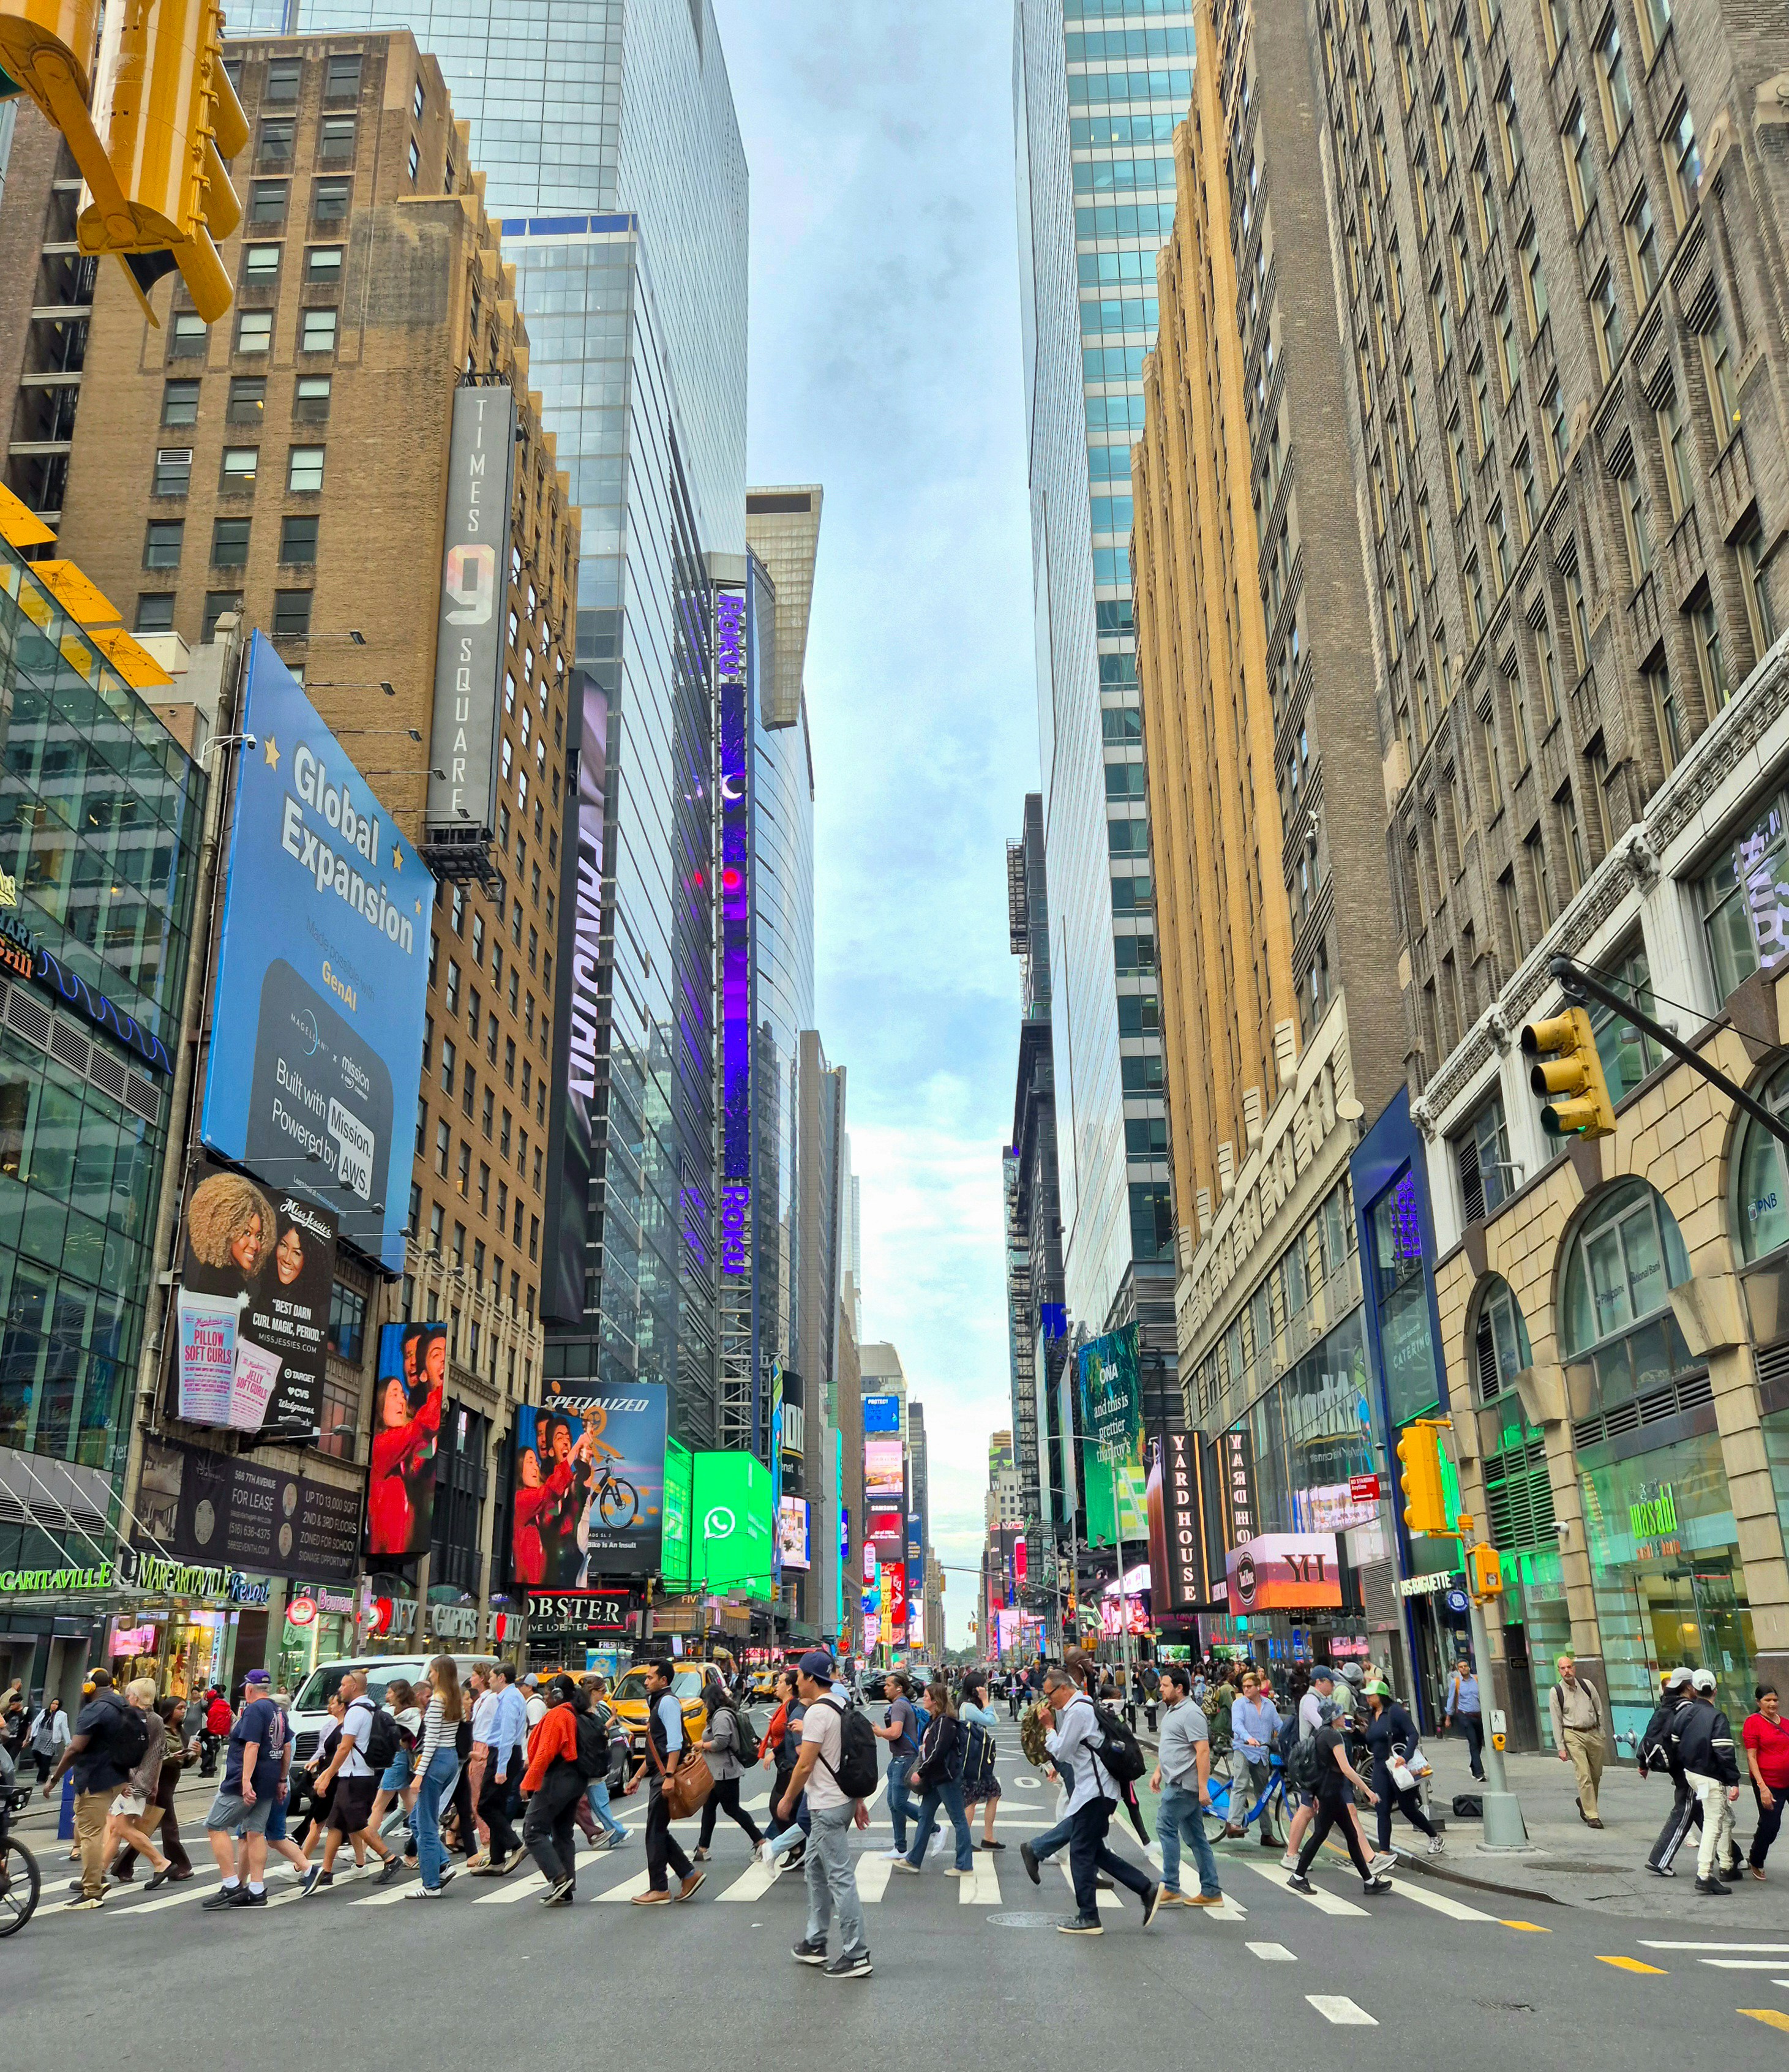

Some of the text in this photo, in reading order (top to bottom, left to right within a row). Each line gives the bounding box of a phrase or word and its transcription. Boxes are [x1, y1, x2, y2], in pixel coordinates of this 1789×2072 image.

[445, 400, 495, 813] TIMES 9 SQUARE
[294, 746, 379, 866] Global
[282, 797, 413, 955] Expansion
[306, 917, 329, 952] Made
[322, 961, 357, 1012] GenAI
[342, 1056, 369, 1092] mission
[276, 1057, 371, 1158] Built with Mission.
[272, 1098, 369, 1194] Powered by AWS.
[1757, 1192, 1777, 1214] PNB
[280, 1198, 332, 1237] Miss Jessie's
[252, 1313, 271, 1330] CURL
[272, 1318, 295, 1337] MAGIC,
[293, 1305, 312, 1321] DARN
[193, 1329, 225, 1347] PILLOW
[258, 1332, 317, 1354] MISSJESSIES.COM
[1393, 1332, 1430, 1368] CATERING
[185, 1345, 232, 1365] SOFT CURLS
[246, 1370, 264, 1384] JELLY
[292, 1370, 315, 1384] TARGET
[1100, 1362, 1119, 1385] ONA
[236, 1377, 252, 1391] SOFT
[250, 1382, 268, 1400] CURLS
[294, 1388, 310, 1399] CVS
[279, 1398, 315, 1414] Walgreens
[541, 1395, 650, 1411] SPECIALIZED
[1094, 1391, 1128, 1419] and this is
[245, 1473, 255, 1484] 7TH
[255, 1476, 276, 1489] AVENUE
[1172, 1435, 1190, 1505] YARD
[232, 1488, 274, 1512] FOR LEASE
[306, 1490, 358, 1515] UP TO 13,000 SQFT
[229, 1522, 271, 1541] (516) 636-4375
[302, 1511, 317, 1525] 2ND
[321, 1515, 334, 1529] 3RD
[334, 1518, 357, 1534] FLOORS
[299, 1531, 320, 1546] ZONED
[320, 1536, 331, 1548] FOR
[298, 1550, 320, 1564] SIGNAGE
[1177, 1511, 1197, 1601] HOUSE
[1281, 1553, 1327, 1582] YH
[0, 1562, 114, 1591] GARITAVILLE
[136, 1552, 271, 1602] MARGARITAVILLE Resort
[1392, 1570, 1452, 1597] RIS BAGUETTE
[681, 1595, 699, 1604] FIV
[389, 1597, 419, 1634] NY
[432, 1604, 478, 1638] GIFTS
